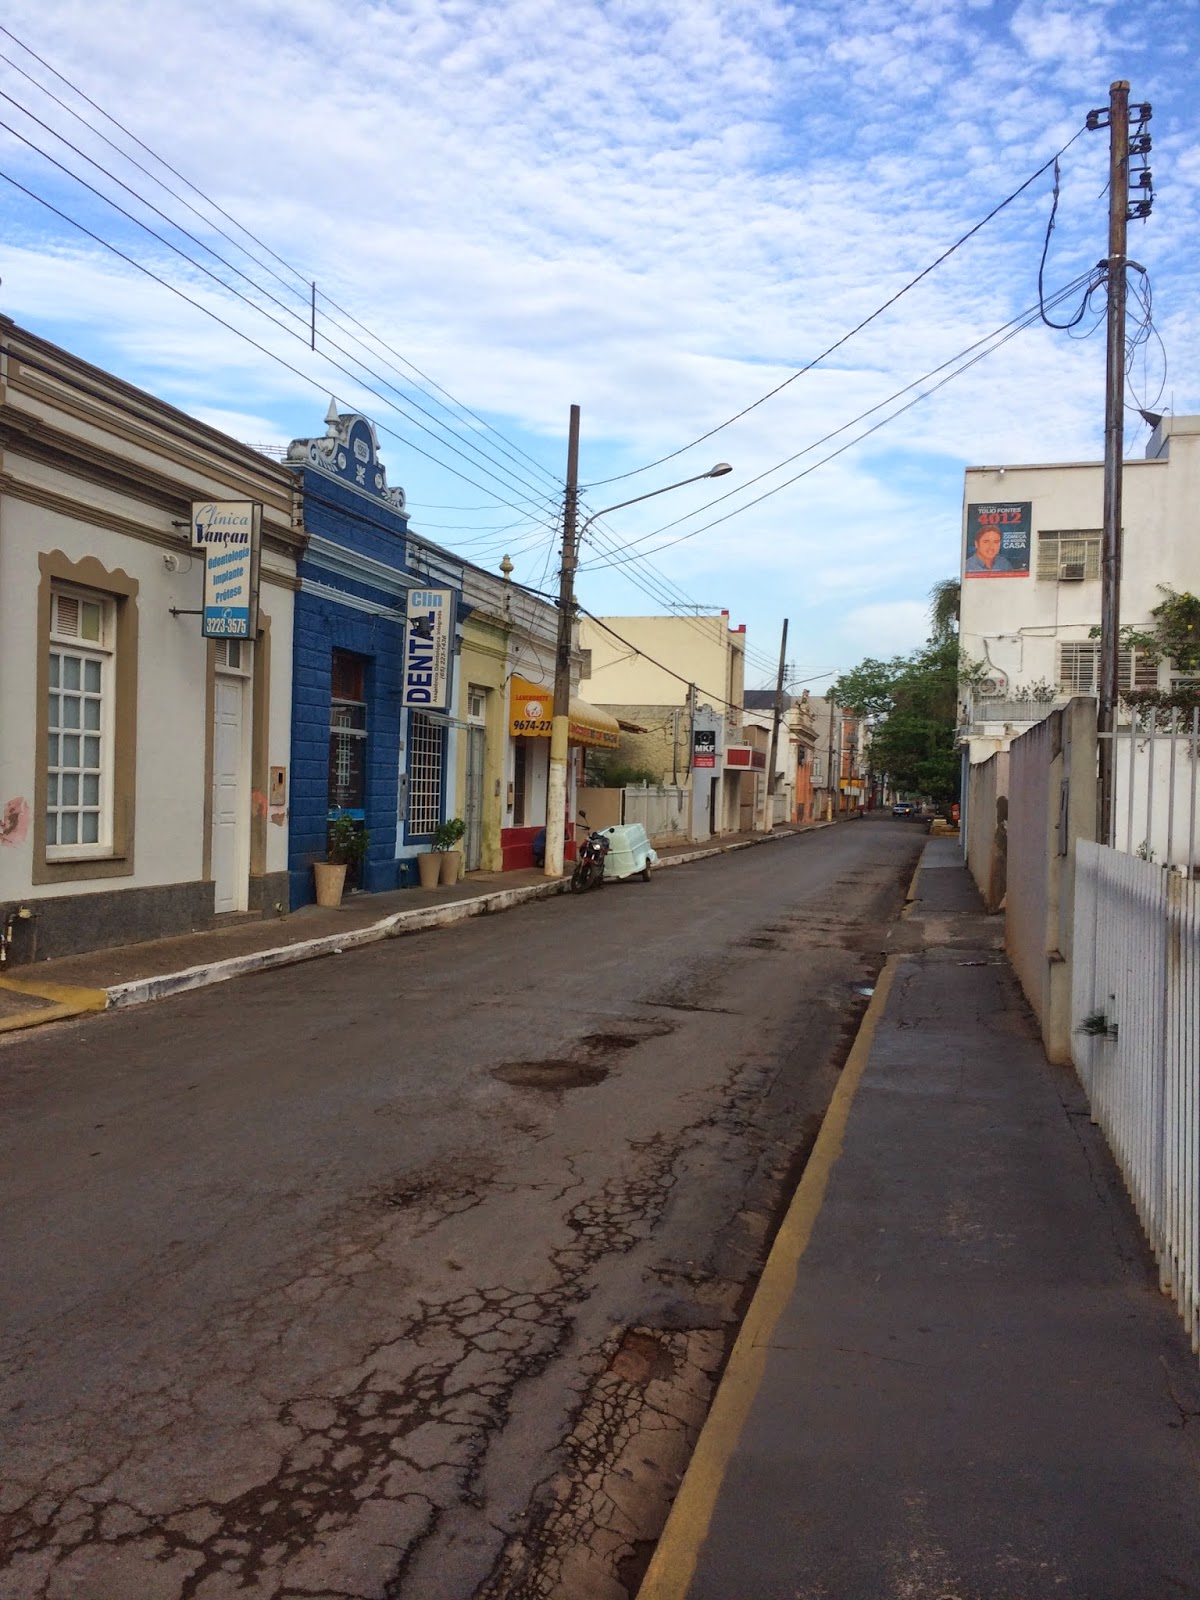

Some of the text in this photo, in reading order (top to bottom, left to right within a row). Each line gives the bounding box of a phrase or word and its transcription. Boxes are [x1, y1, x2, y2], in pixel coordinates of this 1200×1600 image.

[195, 504, 248, 527] Clínica
[978, 512, 1021, 524] 4012
[196, 523, 248, 548] Vançan
[208, 547, 249, 569] Odontologia
[213, 566, 244, 586] Implante
[216, 586, 242, 603] Prótese
[412, 592, 442, 607] Clin
[206, 618, 247, 633] 3223-3575
[434, 637, 442, 672] Odontológica
[514, 720, 553, 730] 9674-27
